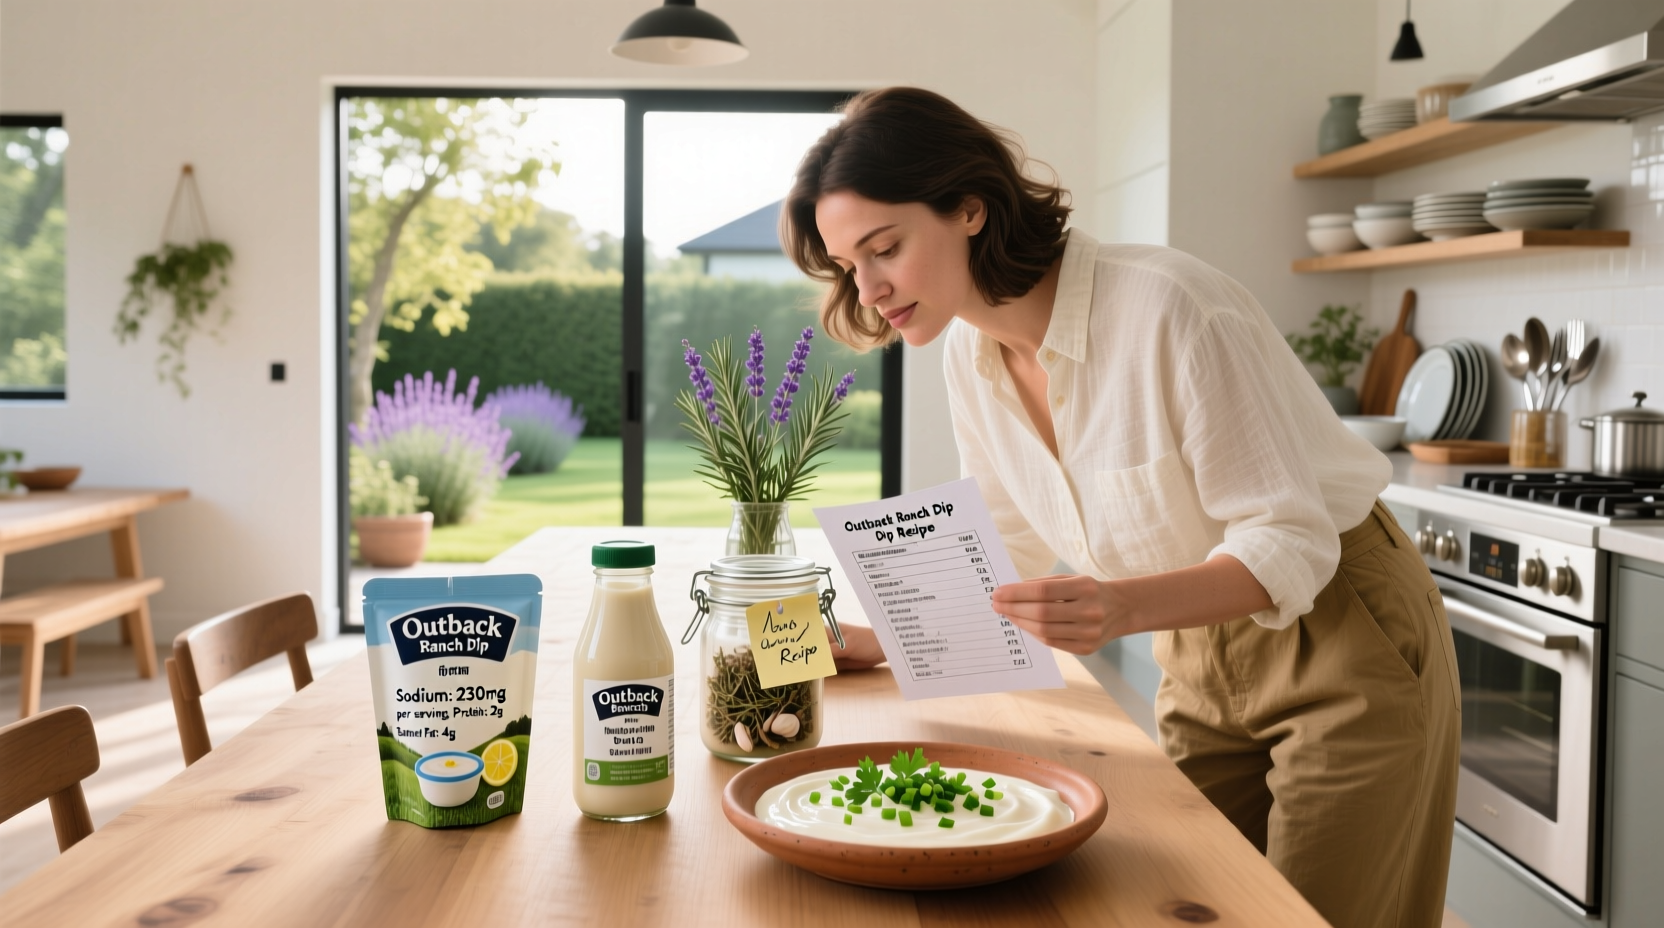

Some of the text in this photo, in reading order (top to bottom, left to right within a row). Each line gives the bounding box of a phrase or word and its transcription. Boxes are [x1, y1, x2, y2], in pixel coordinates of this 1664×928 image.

[932, 501, 954, 517] Dip
[875, 530, 894, 543] Dip
[402, 613, 502, 639] Outback
[420, 637, 463, 653] Ranch
[396, 686, 506, 704] Sodium: 230mg
[598, 688, 659, 705] Outback
[396, 711, 411, 722] per
[489, 705, 504, 718] 2g
[441, 727, 456, 741] 4g
